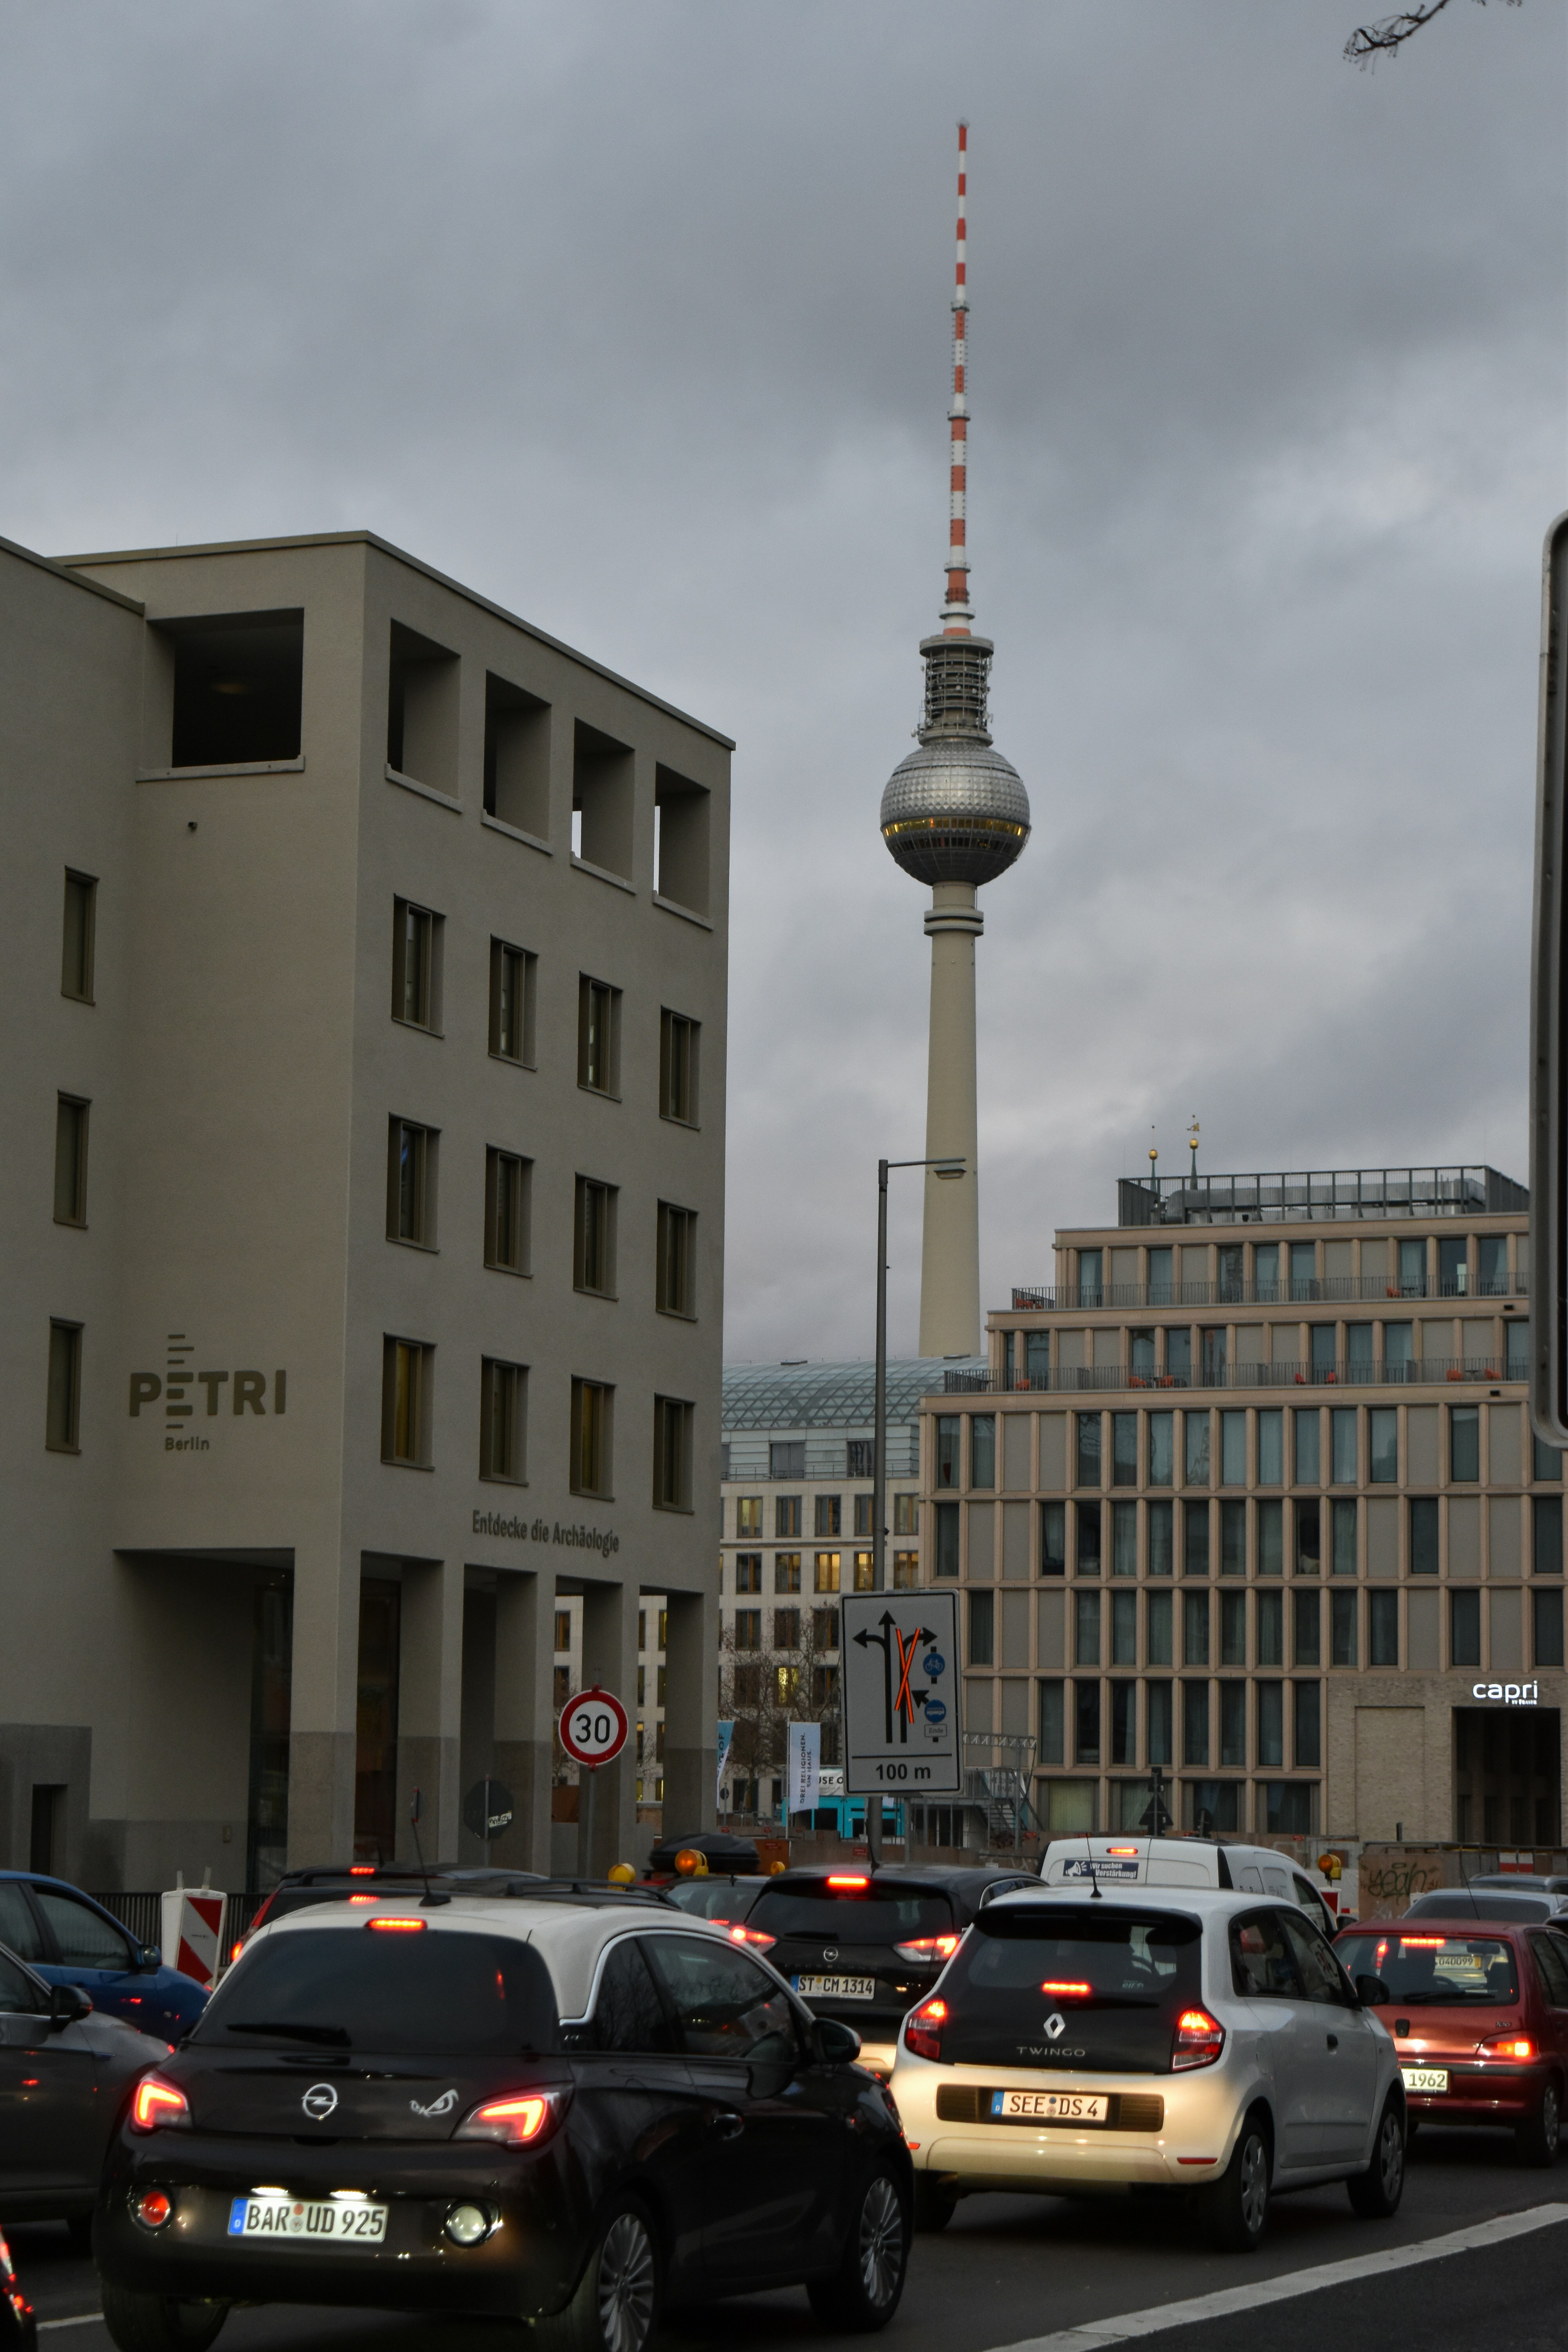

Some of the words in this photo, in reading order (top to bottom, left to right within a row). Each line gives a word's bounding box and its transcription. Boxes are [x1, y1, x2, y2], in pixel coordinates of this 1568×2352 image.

[130, 1370, 286, 1417] PETRI
[165, 1436, 210, 1450] Berlin
[473, 1509, 528, 1539] Entdecke
[531, 1518, 549, 1543] die
[553, 1521, 619, 1558] Archäologie
[1473, 1680, 1538, 1703] capri
[575, 1713, 610, 1743] 30
[876, 1764, 907, 1780] 100
[914, 1766, 931, 1779] m
[1095, 1869, 1136, 1878] Verstärkung!
[799, 1977, 815, 1991] ST
[823, 1978, 840, 1992] CM
[841, 1978, 872, 1994] 1314
[1016, 2047, 1085, 2057] TWINGO
[1409, 2072, 1445, 2087] 1962
[1009, 2095, 1045, 2114] SEE
[1058, 2097, 1083, 2116] DS
[1087, 2100, 1098, 2117] 4
[234, 2219, 240, 2227] D
[247, 2204, 290, 2231] BAR
[306, 2206, 336, 2233] UD
[342, 2209, 384, 2235] 925
